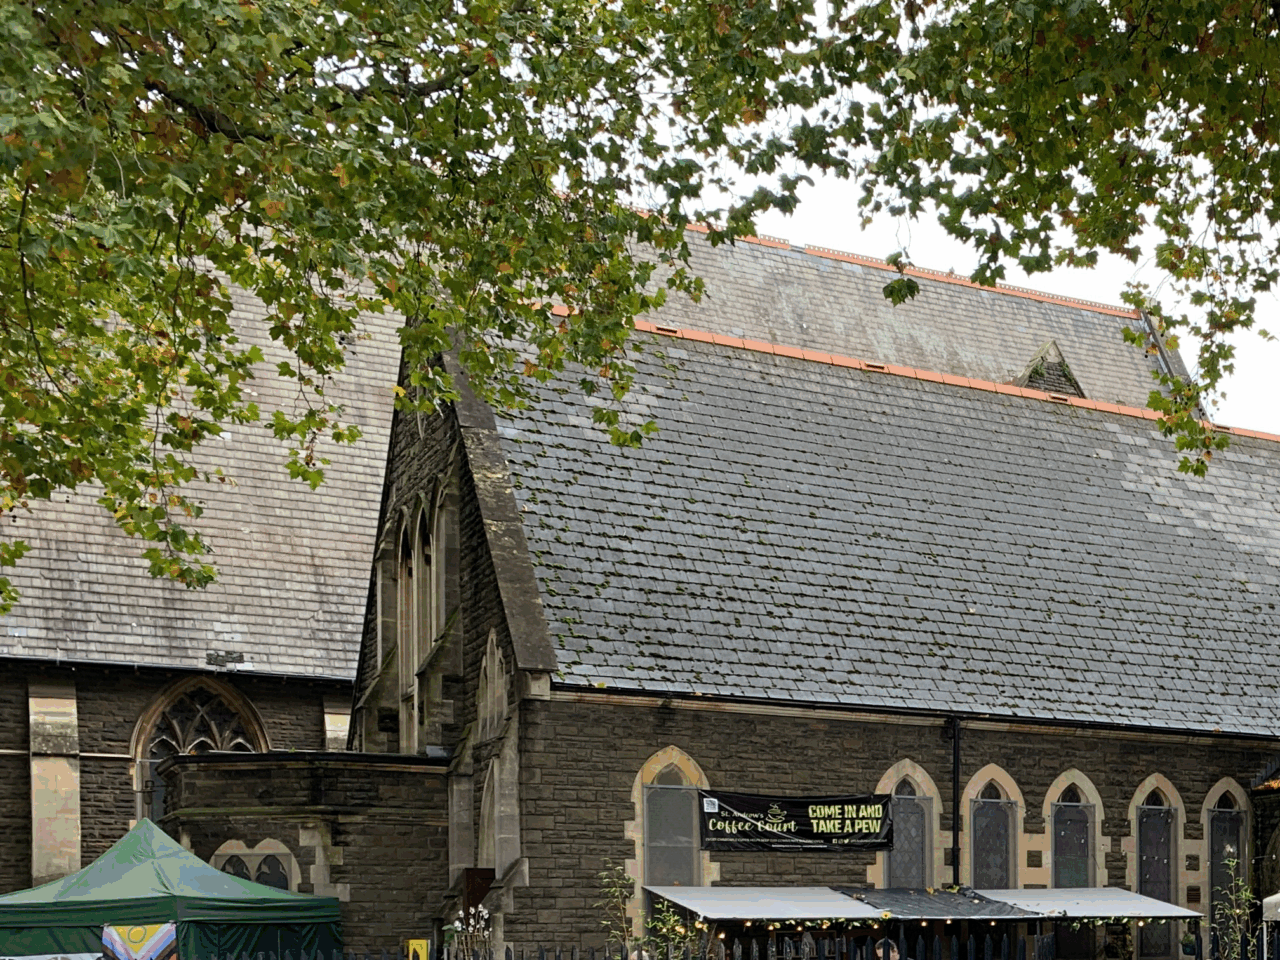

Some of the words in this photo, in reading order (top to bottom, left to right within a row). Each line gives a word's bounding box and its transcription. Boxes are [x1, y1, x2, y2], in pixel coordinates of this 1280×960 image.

[808, 805, 842, 819] COME
[844, 804, 857, 819] IN
[859, 804, 883, 819] AND
[708, 818, 754, 834] Coffee
[757, 820, 798, 833] Court
[810, 819, 842, 833] TAKE
[843, 819, 853, 833] A
[855, 819, 882, 833] PEW
